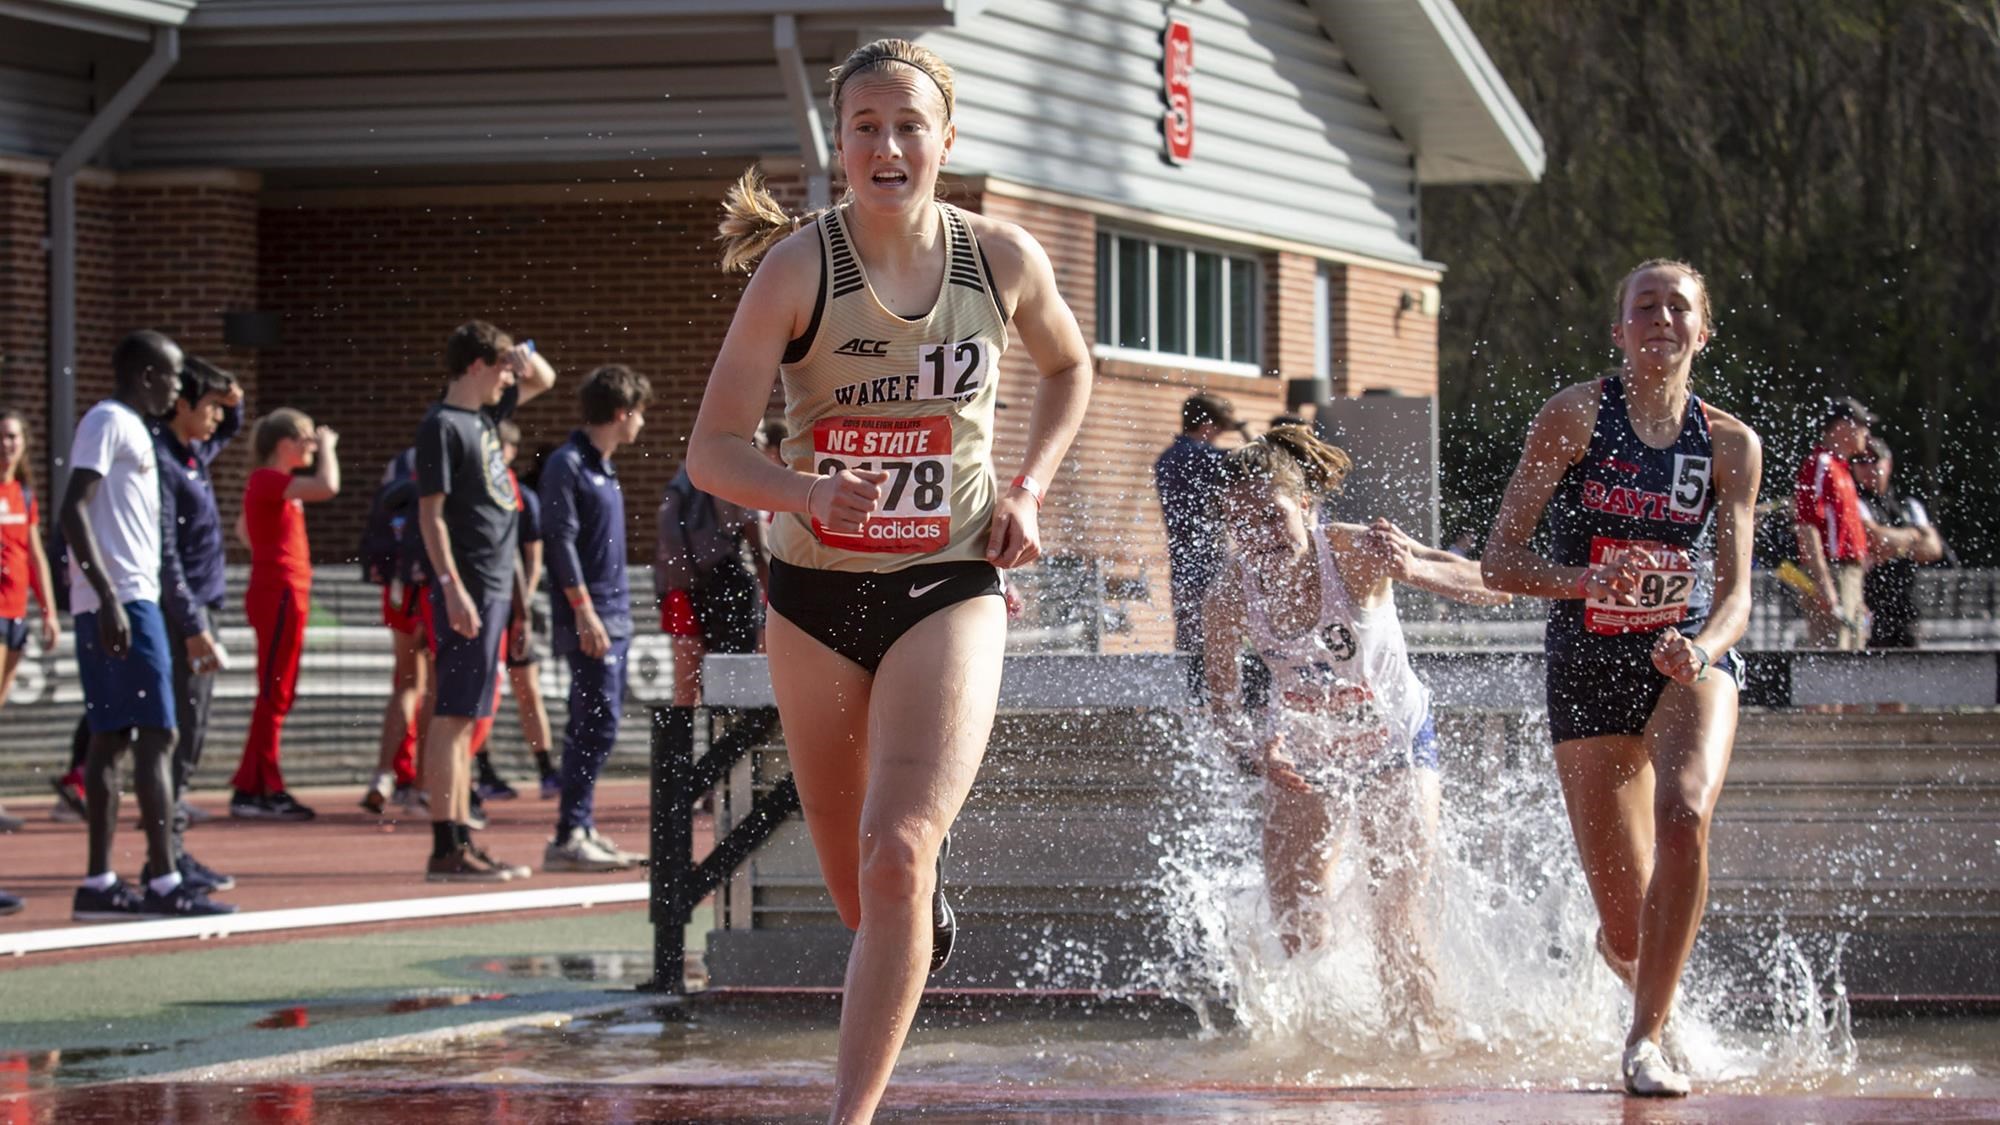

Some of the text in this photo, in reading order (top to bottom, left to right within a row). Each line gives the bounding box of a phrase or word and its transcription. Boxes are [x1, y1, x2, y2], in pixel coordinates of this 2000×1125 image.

[834, 338, 891, 357] ACC
[925, 342, 980, 396] 12
[834, 376, 901, 407] WAKE
[827, 430, 932, 454] NC STATE
[1675, 458, 1707, 509] 5
[1582, 479, 1703, 525] DAYT
[868, 521, 941, 539] adidas
[1322, 622, 1357, 662] 9
